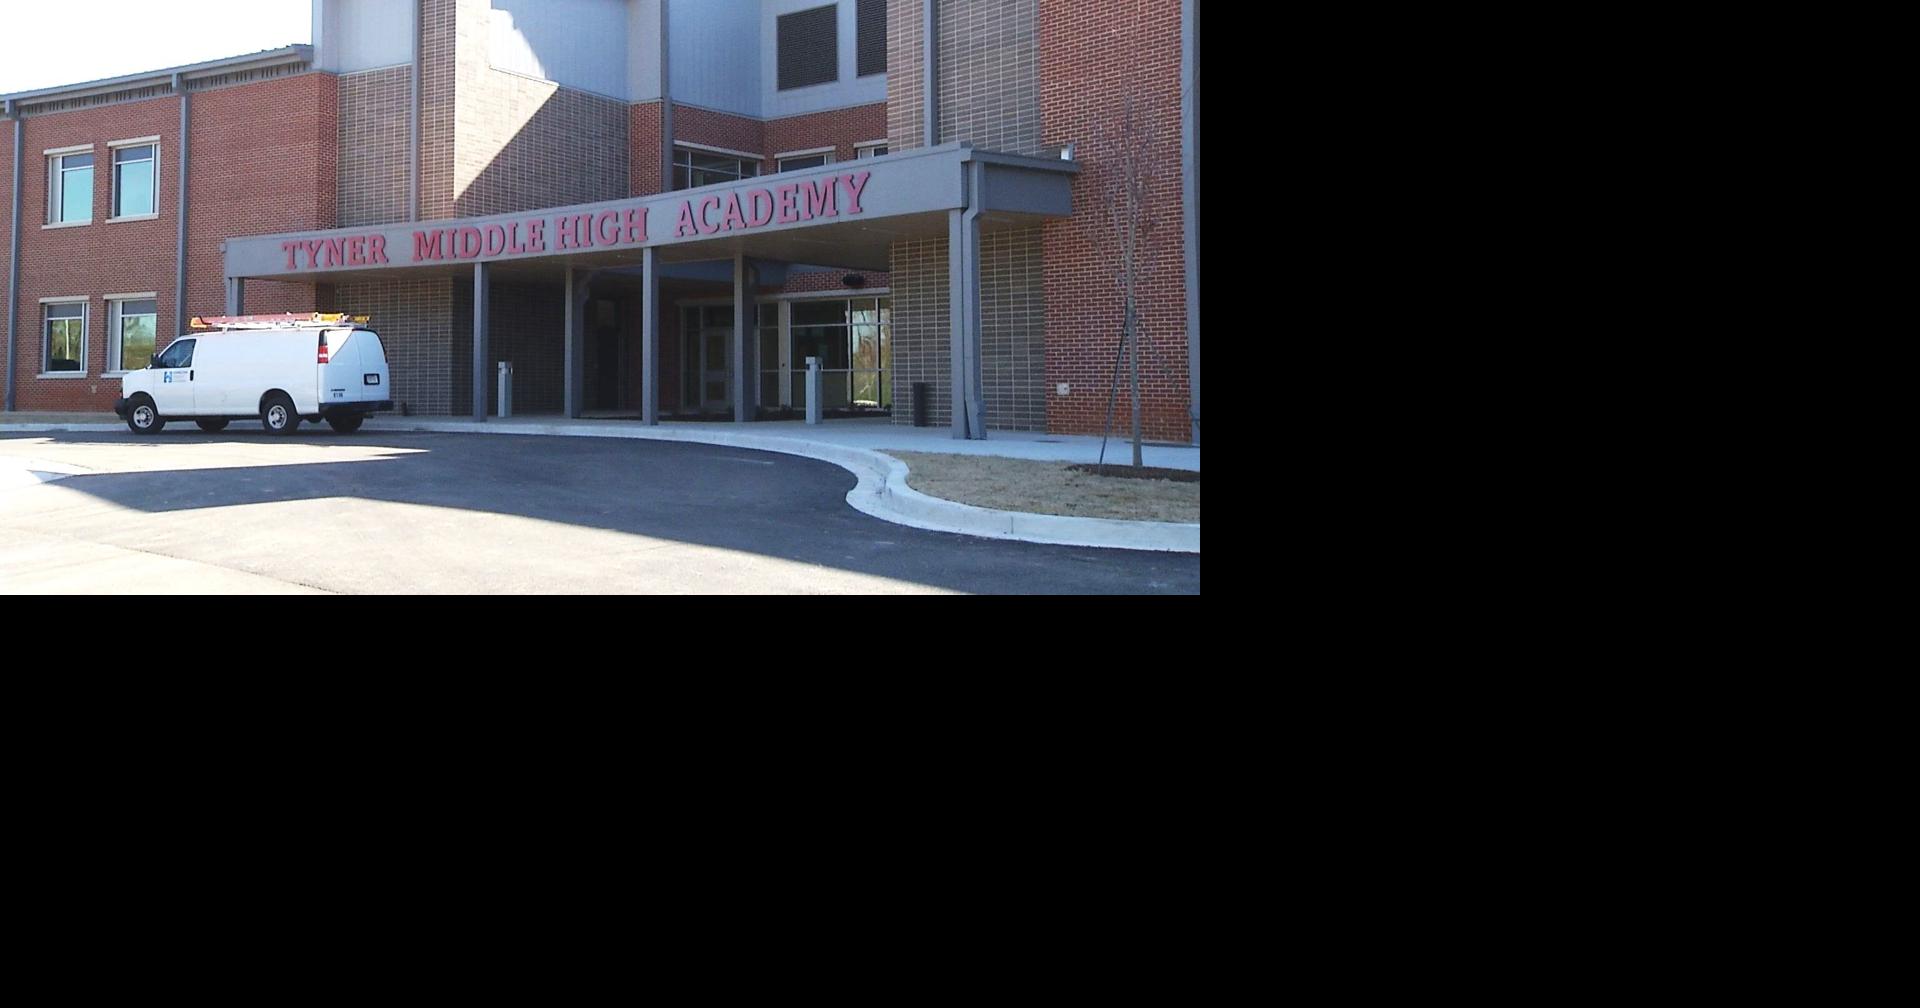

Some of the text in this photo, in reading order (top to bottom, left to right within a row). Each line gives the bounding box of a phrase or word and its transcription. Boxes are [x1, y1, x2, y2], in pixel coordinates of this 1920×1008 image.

[282, 171, 871, 270] TYNER MIDDLE HIGH ACADEMY
